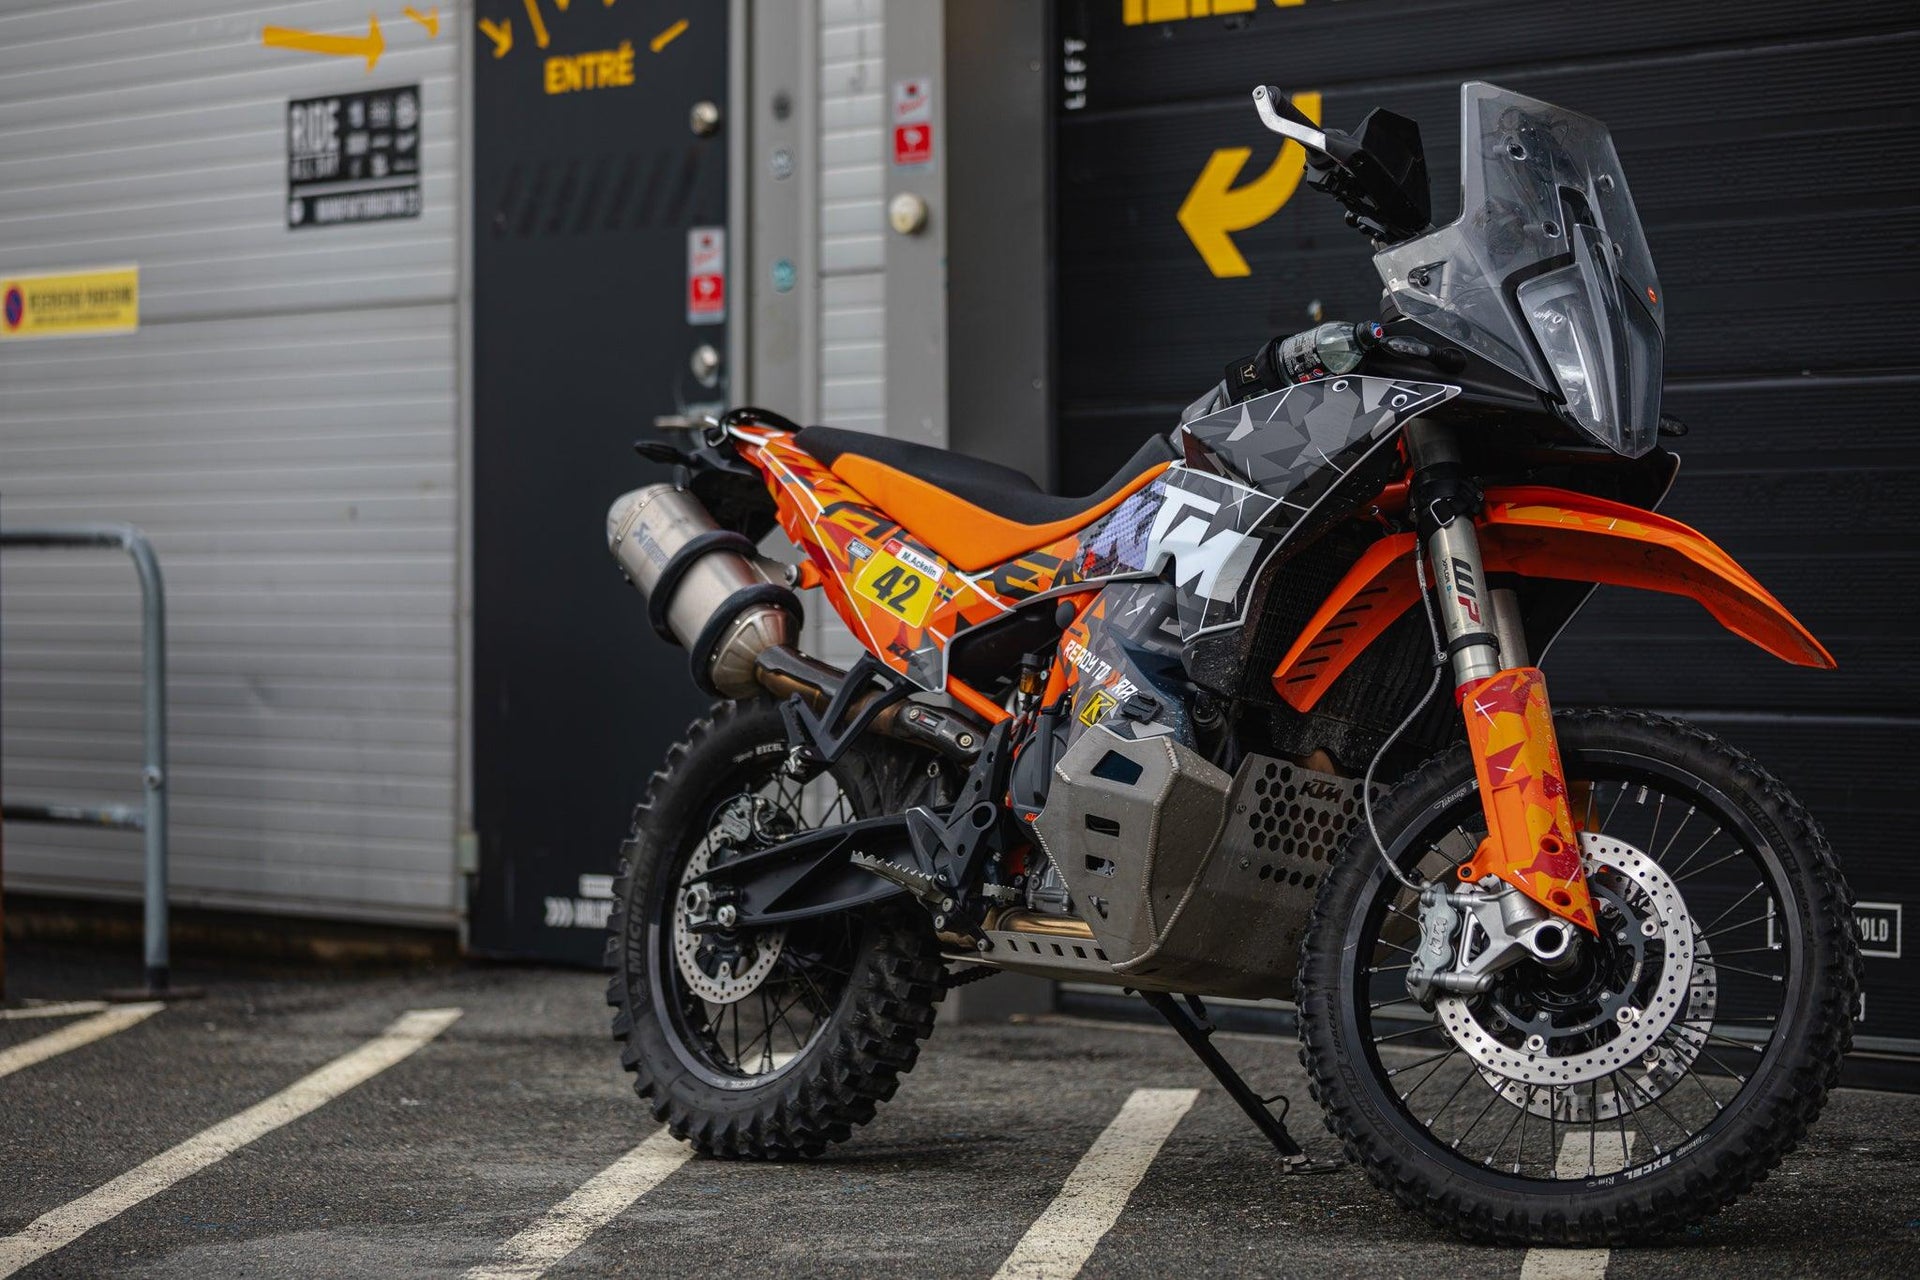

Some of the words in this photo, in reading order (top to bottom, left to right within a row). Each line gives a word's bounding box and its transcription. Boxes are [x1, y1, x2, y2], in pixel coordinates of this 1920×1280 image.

[544, 39, 635, 94] ENTRÉ
[1064, 37, 1087, 110] LEFT
[901, 550, 938, 578] M.Ackelin
[871, 565, 921, 614] 42
[1451, 556, 1483, 625] WP
[1062, 639, 1099, 674] READY
[1091, 660, 1112, 681] TO
[1299, 778, 1344, 803] KTM
[1857, 916, 1889, 942] OLD
[1326, 992, 1344, 1058] TRACKER
[1623, 1155, 1672, 1180] EXCEL
